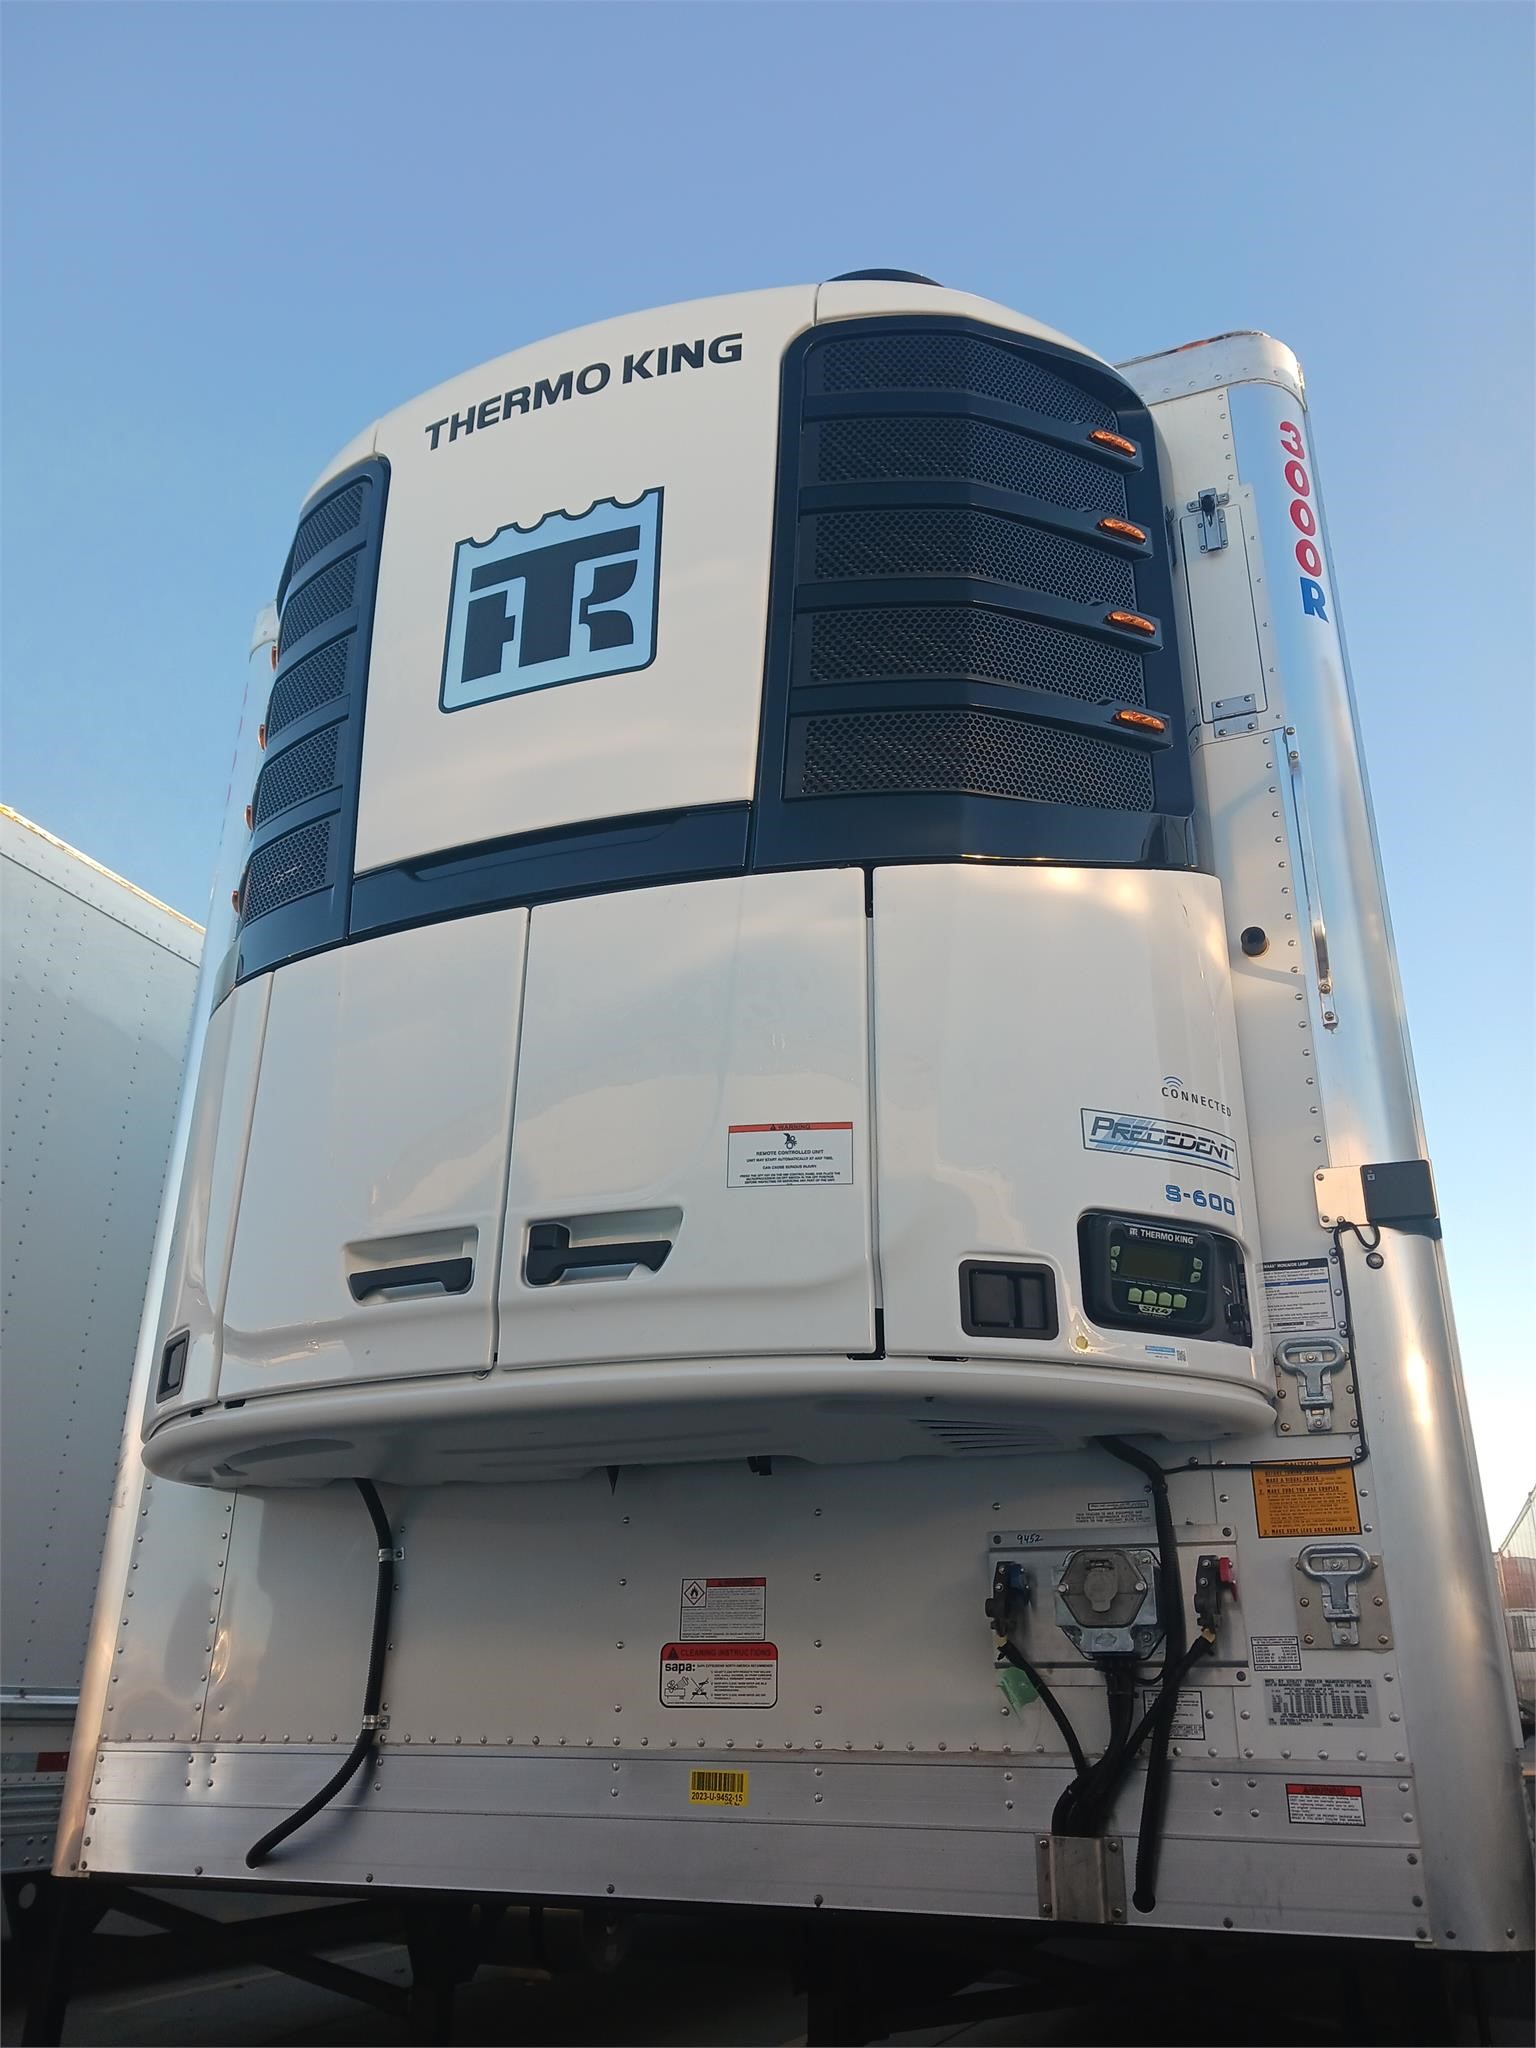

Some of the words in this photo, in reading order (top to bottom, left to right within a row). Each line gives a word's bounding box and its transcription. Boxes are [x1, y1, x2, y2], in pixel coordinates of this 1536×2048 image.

[424, 362, 611, 451] THERMO
[622, 332, 743, 384] KING
[1280, 420, 1330, 623] 3000R
[1161, 1086, 1232, 1118] CONNECTED
[1090, 1116, 1235, 1162] PRECEDENT
[1164, 1184, 1236, 1217] S-600
[1140, 1229, 1174, 1242] THERMO
[1174, 1234, 1194, 1245] KING
[1016, 1533, 1044, 1544] 9452
[680, 1648, 716, 1657] CLEANING
[718, 1648, 771, 1657] INSTRUCTIONS
[692, 1791, 744, 1802] 2023-U-9452-15
